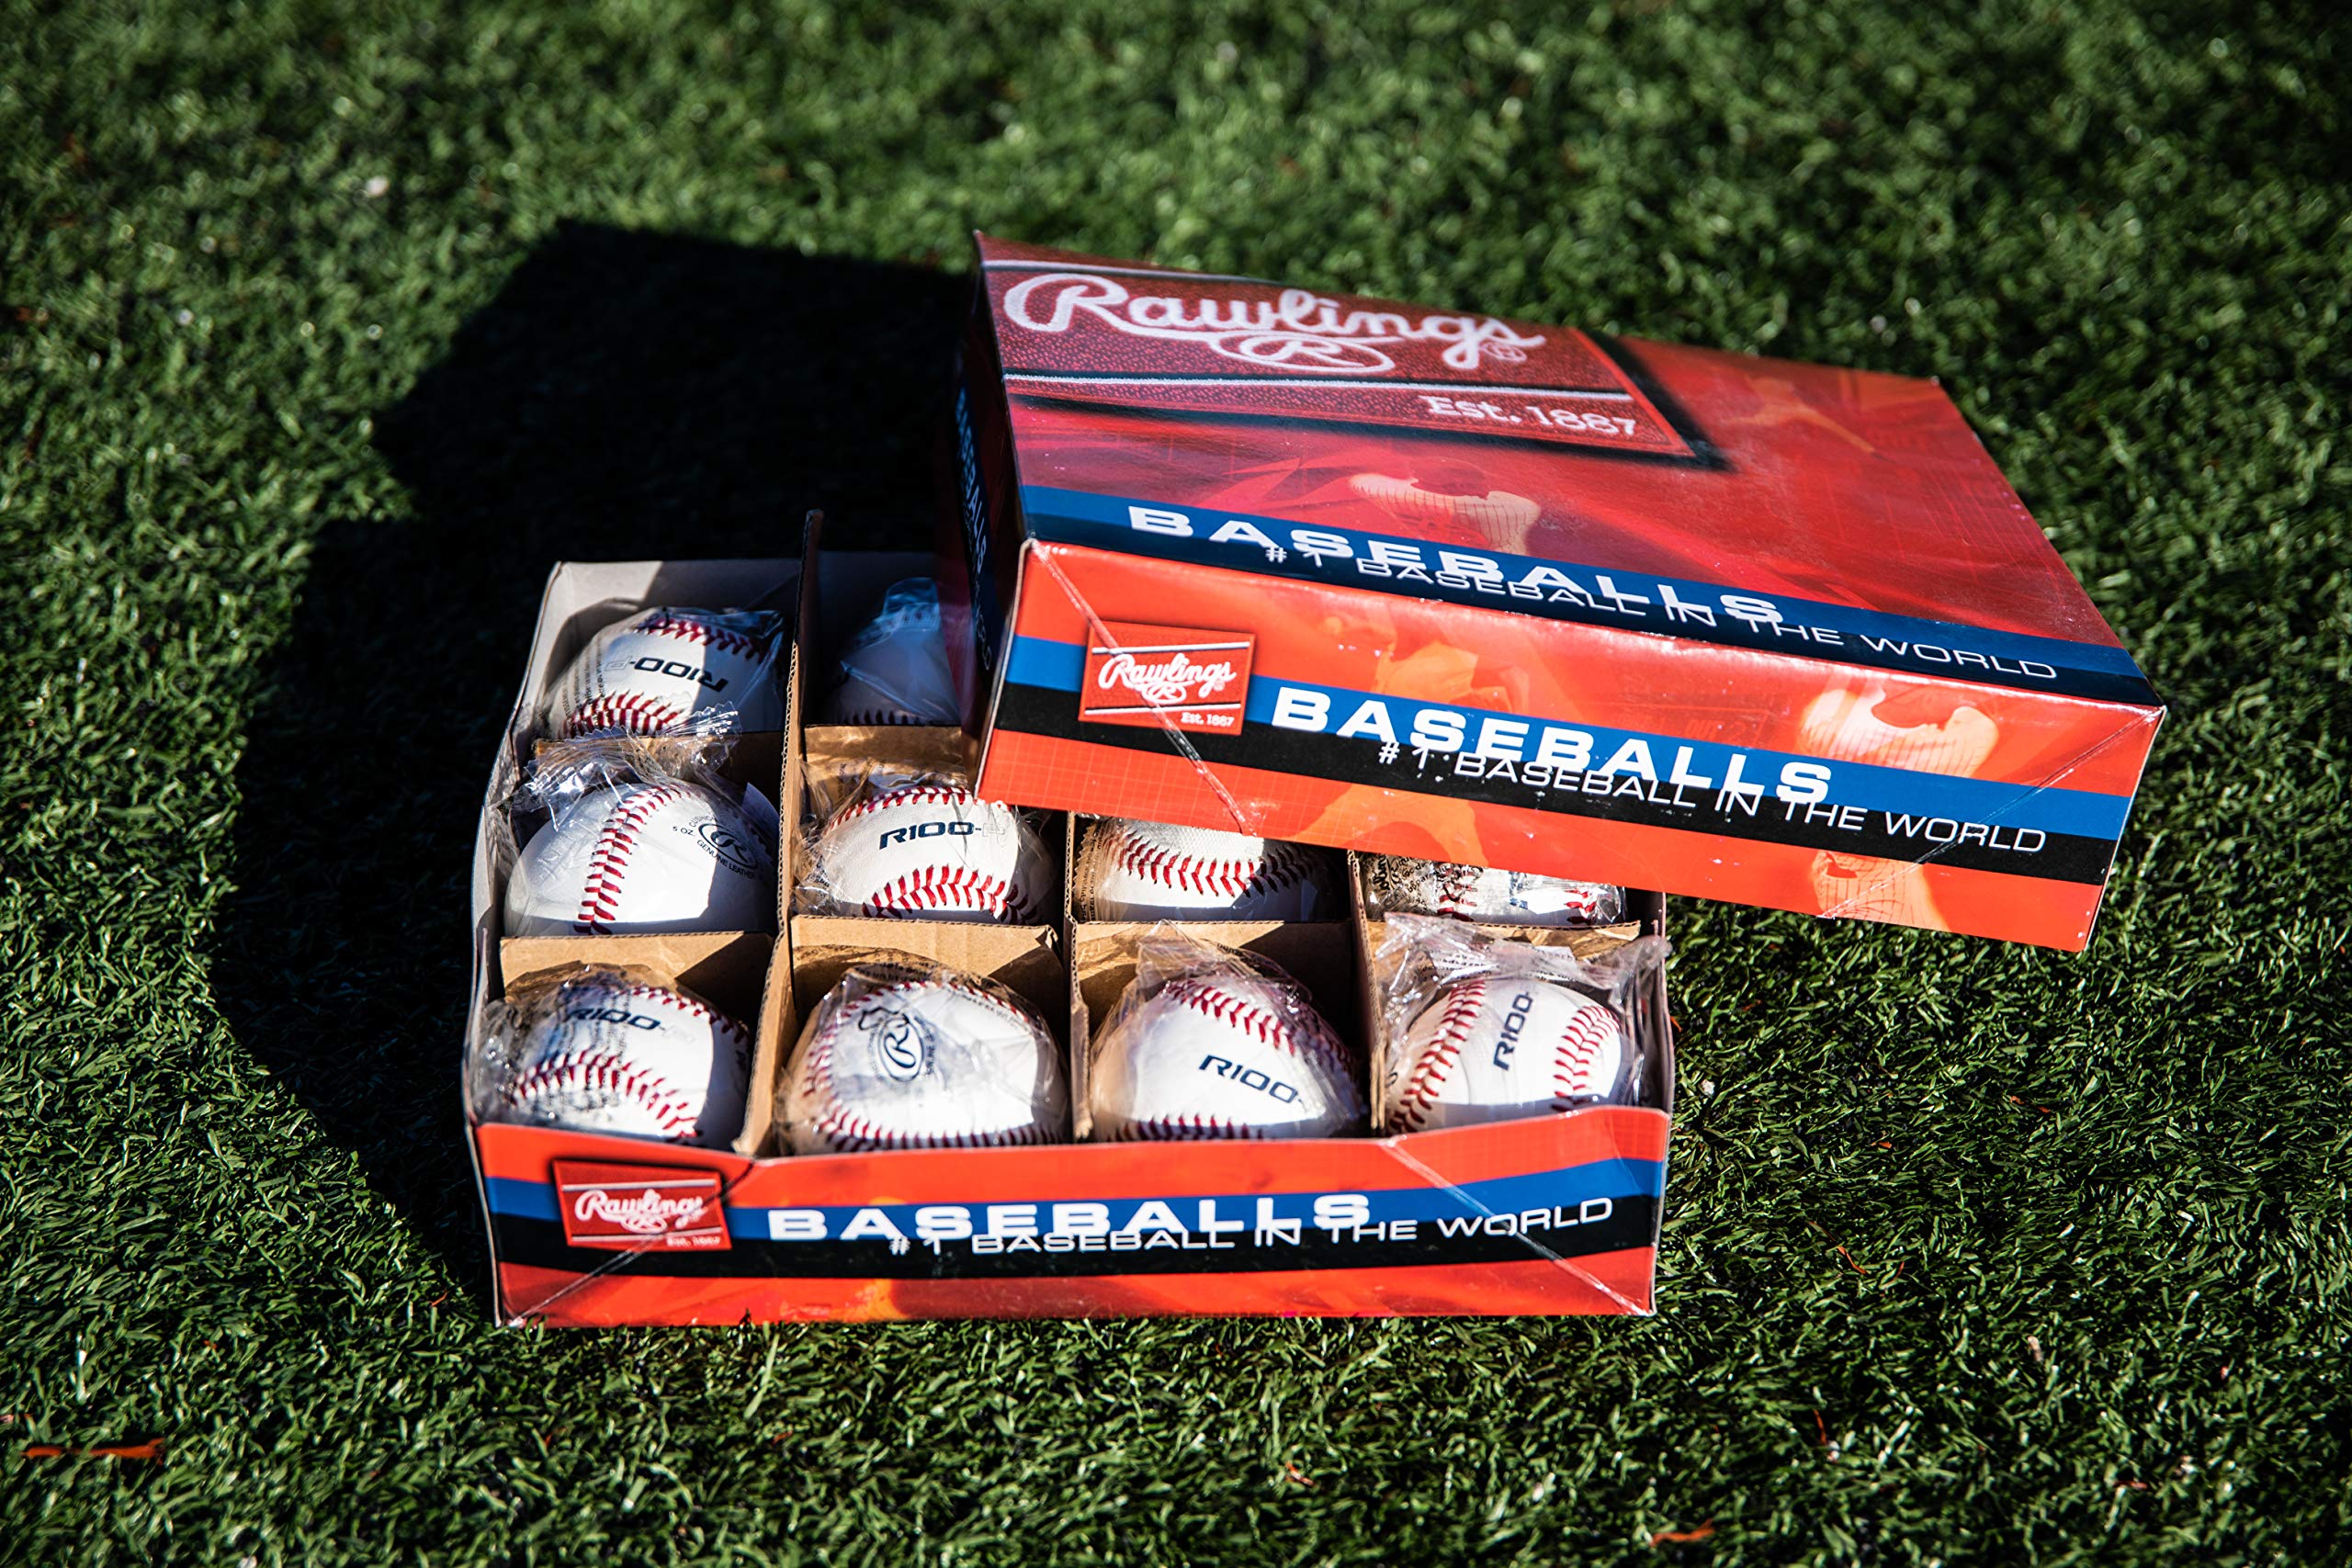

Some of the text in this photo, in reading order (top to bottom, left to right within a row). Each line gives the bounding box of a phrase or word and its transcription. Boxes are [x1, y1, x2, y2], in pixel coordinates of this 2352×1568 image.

[1003, 273, 1546, 373] Rawlings
[1419, 394, 1637, 436] Est. 1887
[1128, 505, 1784, 624] BASEBALLS
[1356, 558, 1646, 616] BASEBALL
[1664, 604, 1717, 627] IN
[1736, 615, 1845, 646] THE
[1860, 634, 2058, 679] WORLD
[1098, 653, 1238, 705] Rawlings
[1181, 712, 1204, 726] Est.
[1272, 686, 1832, 804] BASEBALLS
[1453, 751, 1697, 808] BASEBALL
[1714, 788, 1762, 817] IN
[1781, 798, 1869, 831] THE
[1883, 810, 2047, 853] WORLD
[696, 839, 729, 868] GENUINE
[574, 1189, 708, 1235] Rawlings
[768, 1193, 1370, 1240] BASEBALLS
[972, 1229, 1236, 1255] BASEBALL
[1254, 1227, 1302, 1247] IN
[1326, 1220, 1419, 1244] THE
[1436, 1197, 1613, 1237] WORLD
